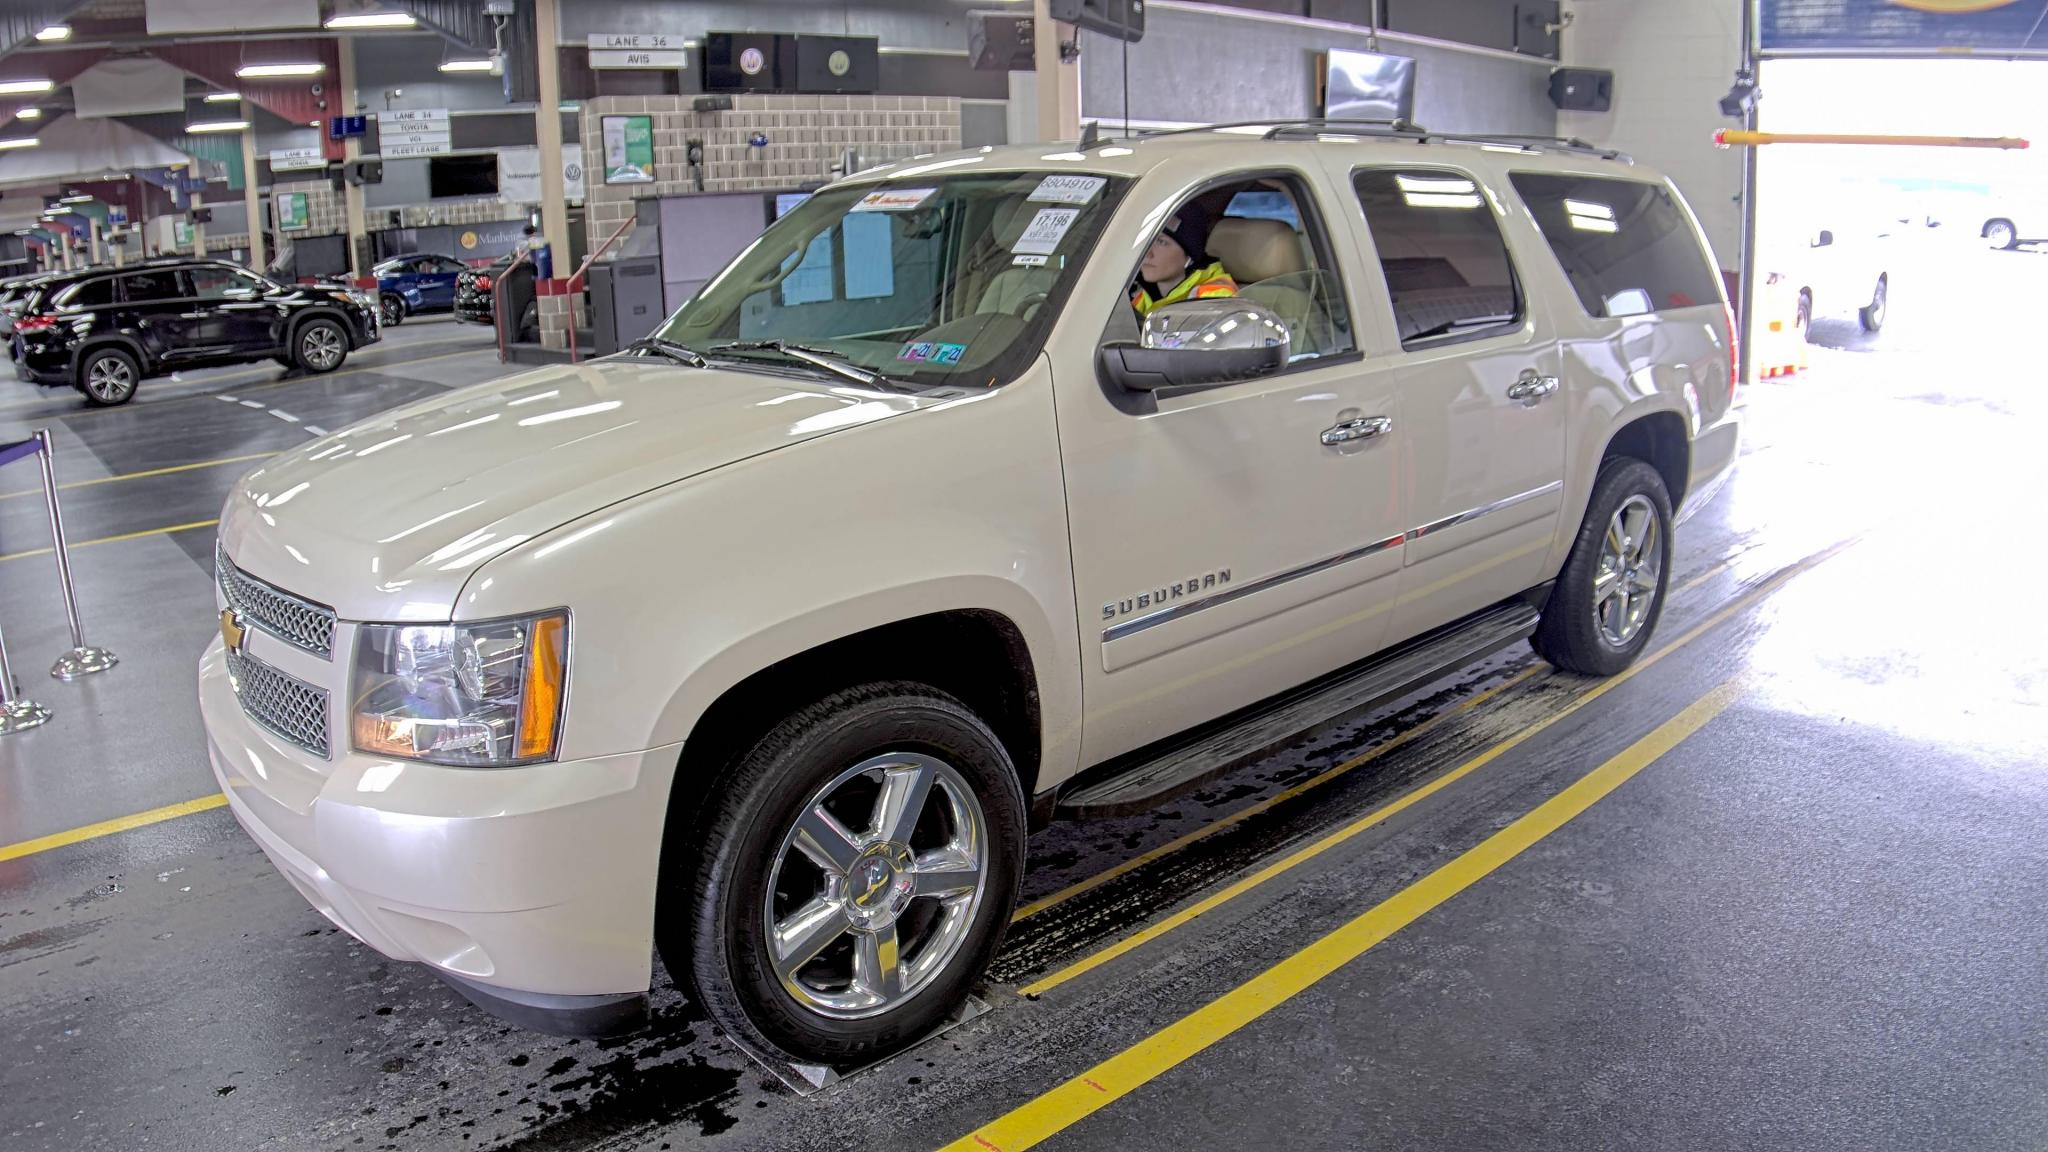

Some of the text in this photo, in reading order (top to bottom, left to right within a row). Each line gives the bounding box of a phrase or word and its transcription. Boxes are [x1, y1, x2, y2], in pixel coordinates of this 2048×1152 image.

[606, 36, 667, 47] LANE 36
[627, 53, 650, 64] AVIS
[394, 111, 415, 121] LANE
[1102, 568, 1231, 620] SUBURBAN
